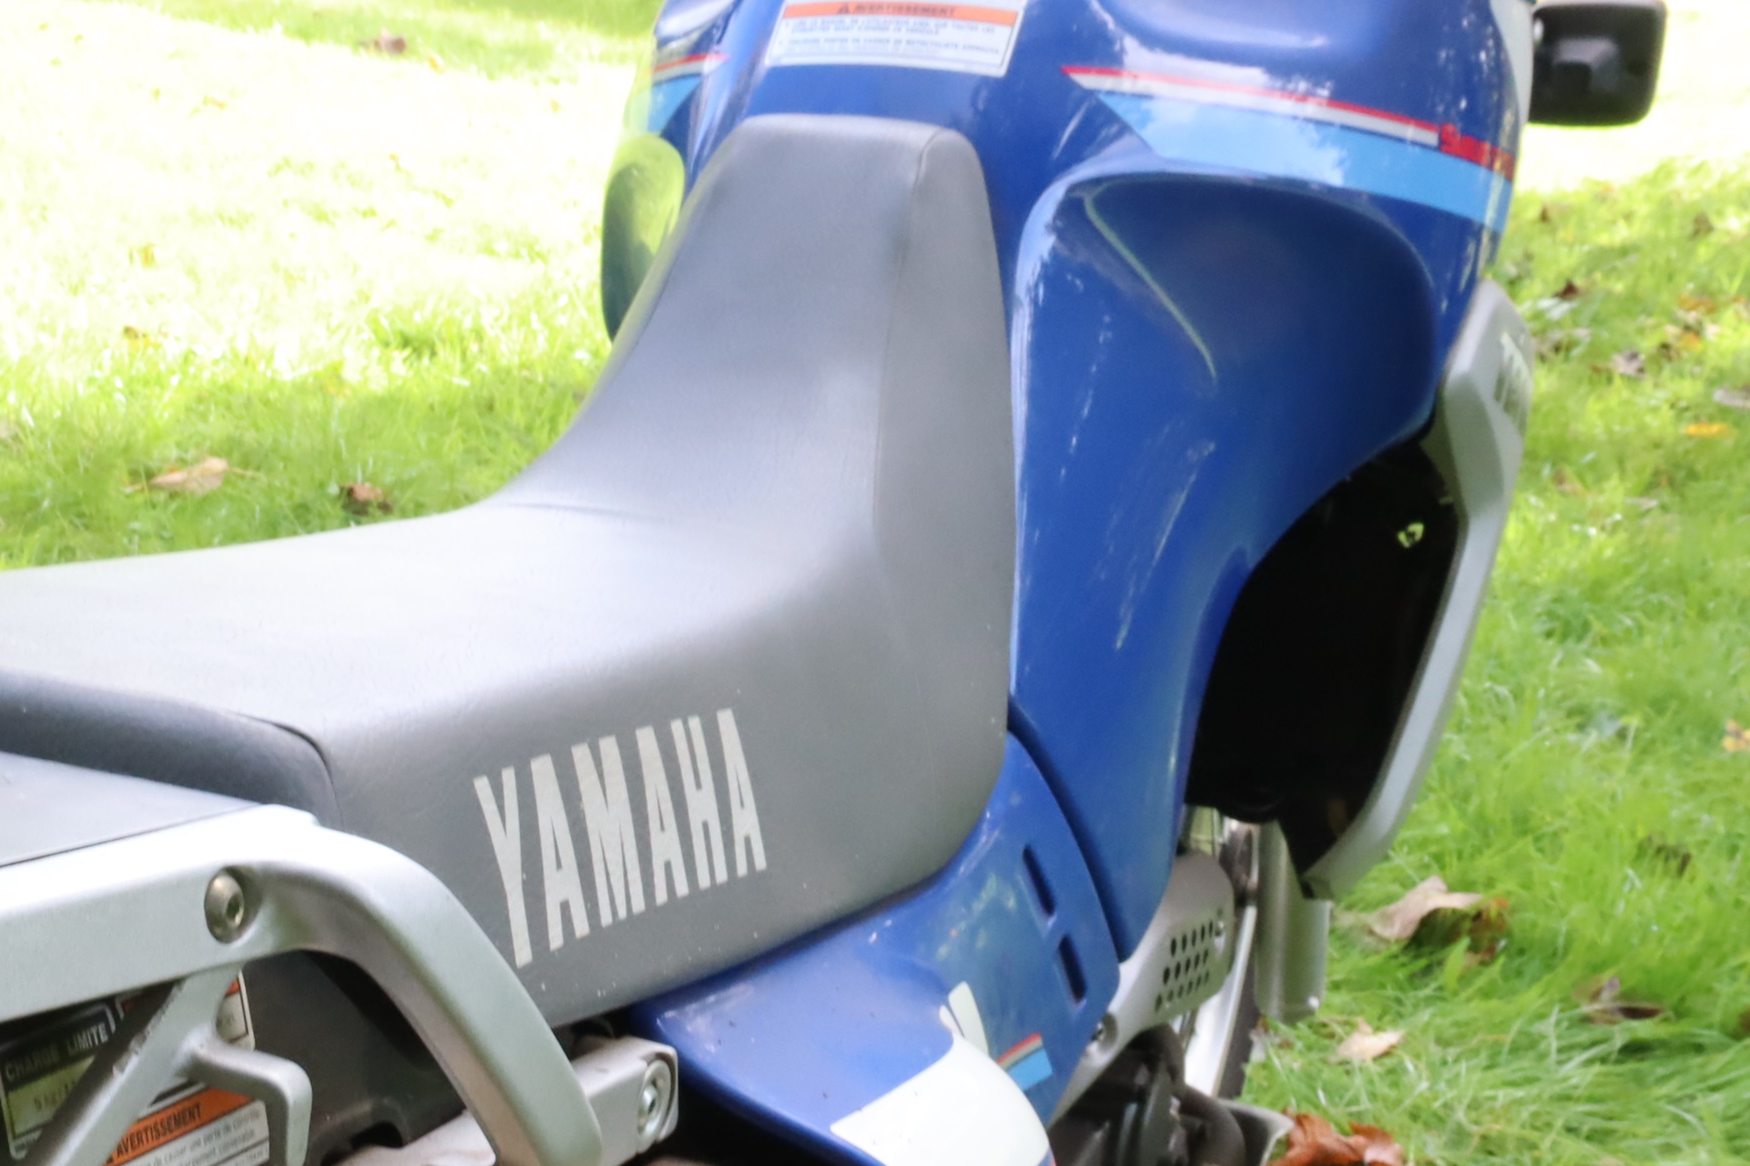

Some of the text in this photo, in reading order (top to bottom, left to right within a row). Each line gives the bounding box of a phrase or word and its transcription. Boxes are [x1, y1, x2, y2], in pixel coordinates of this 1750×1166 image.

[473, 708, 767, 968] YAMAHA
[4, 1022, 109, 1081] CHARGE LIMITE
[116, 1102, 202, 1158] AVERTISSEMENT
